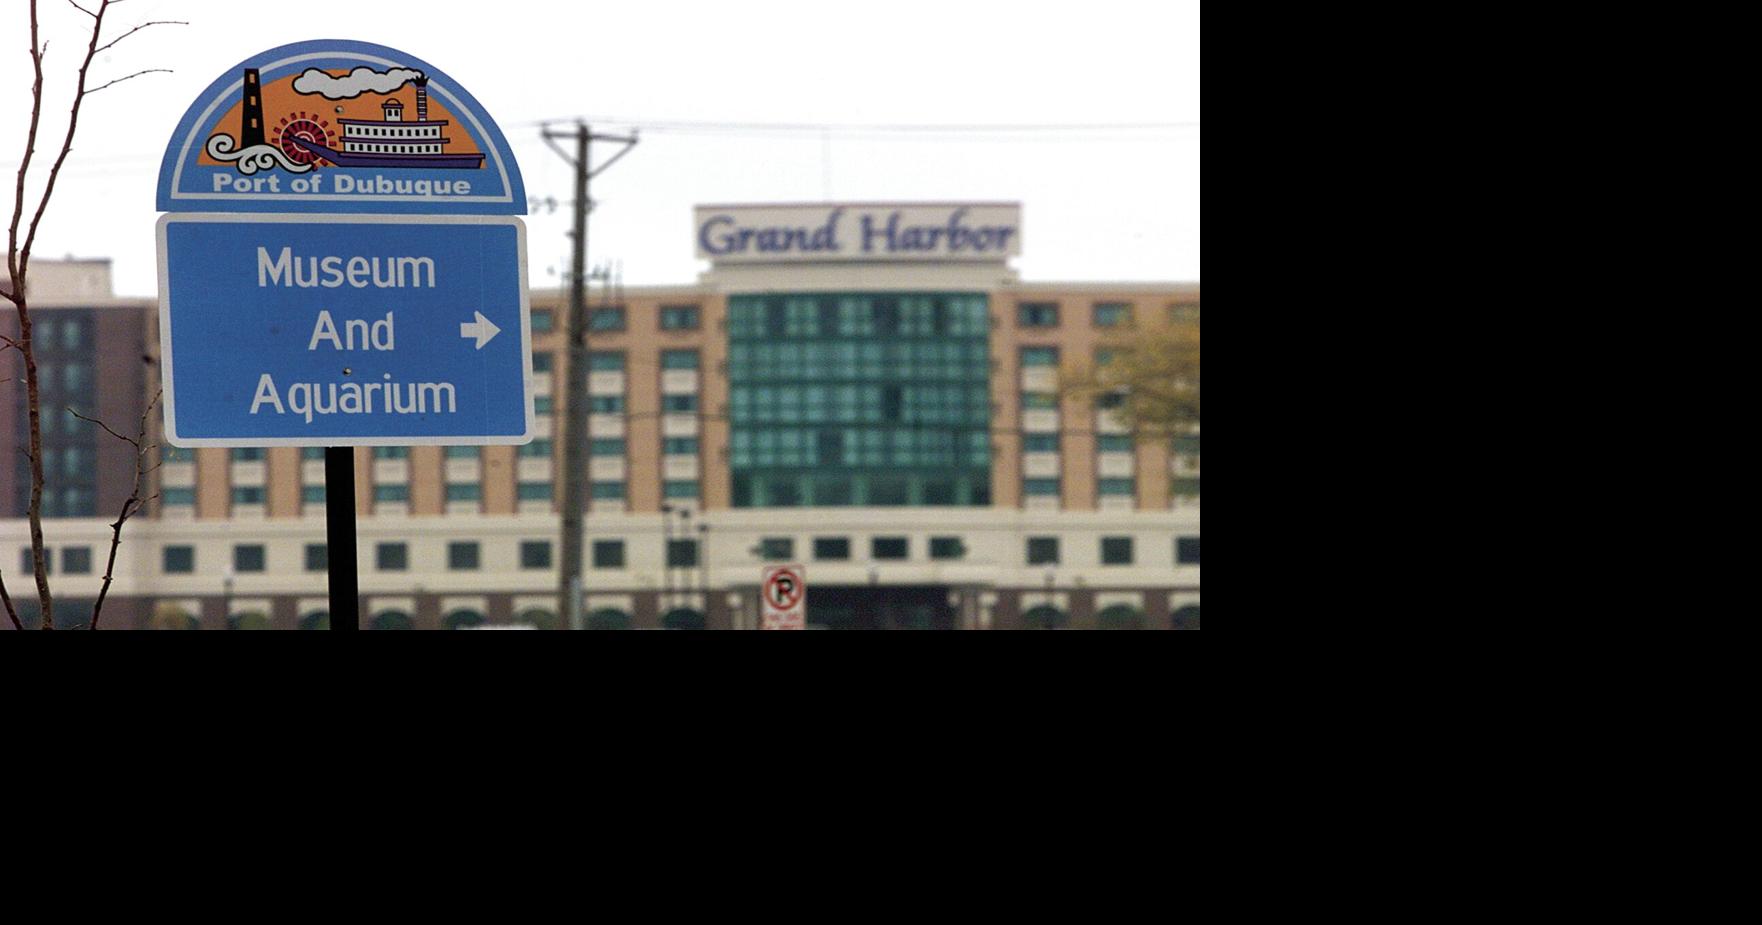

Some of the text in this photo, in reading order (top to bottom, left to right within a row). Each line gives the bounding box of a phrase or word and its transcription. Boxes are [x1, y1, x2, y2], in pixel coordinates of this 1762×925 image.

[212, 173, 471, 197] Port of Dubuque
[699, 206, 1016, 256] Grand Harbor
[257, 247, 436, 287] Museum
[308, 310, 395, 351] And
[249, 374, 457, 424] Aquarium
